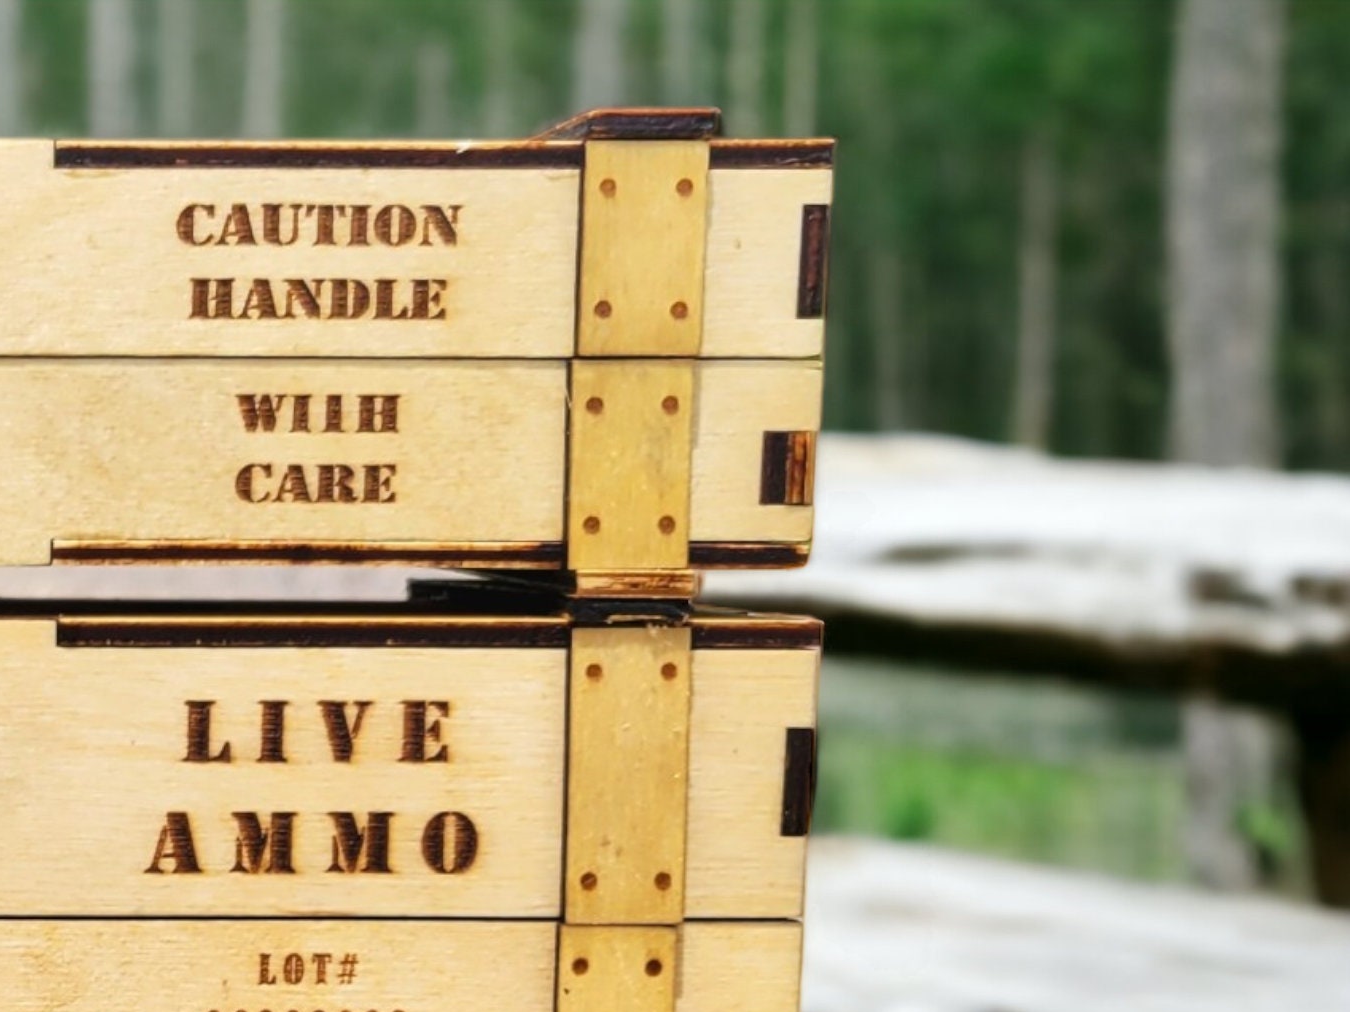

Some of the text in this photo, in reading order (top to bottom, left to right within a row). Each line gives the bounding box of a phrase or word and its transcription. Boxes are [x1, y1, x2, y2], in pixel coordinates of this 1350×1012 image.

[176, 204, 463, 246] CAUTION
[189, 277, 448, 320] HANDLE
[235, 463, 397, 503] CARE
[182, 700, 451, 763] LIVE
[144, 811, 479, 874] AMMO
[257, 953, 360, 985] LOT#
